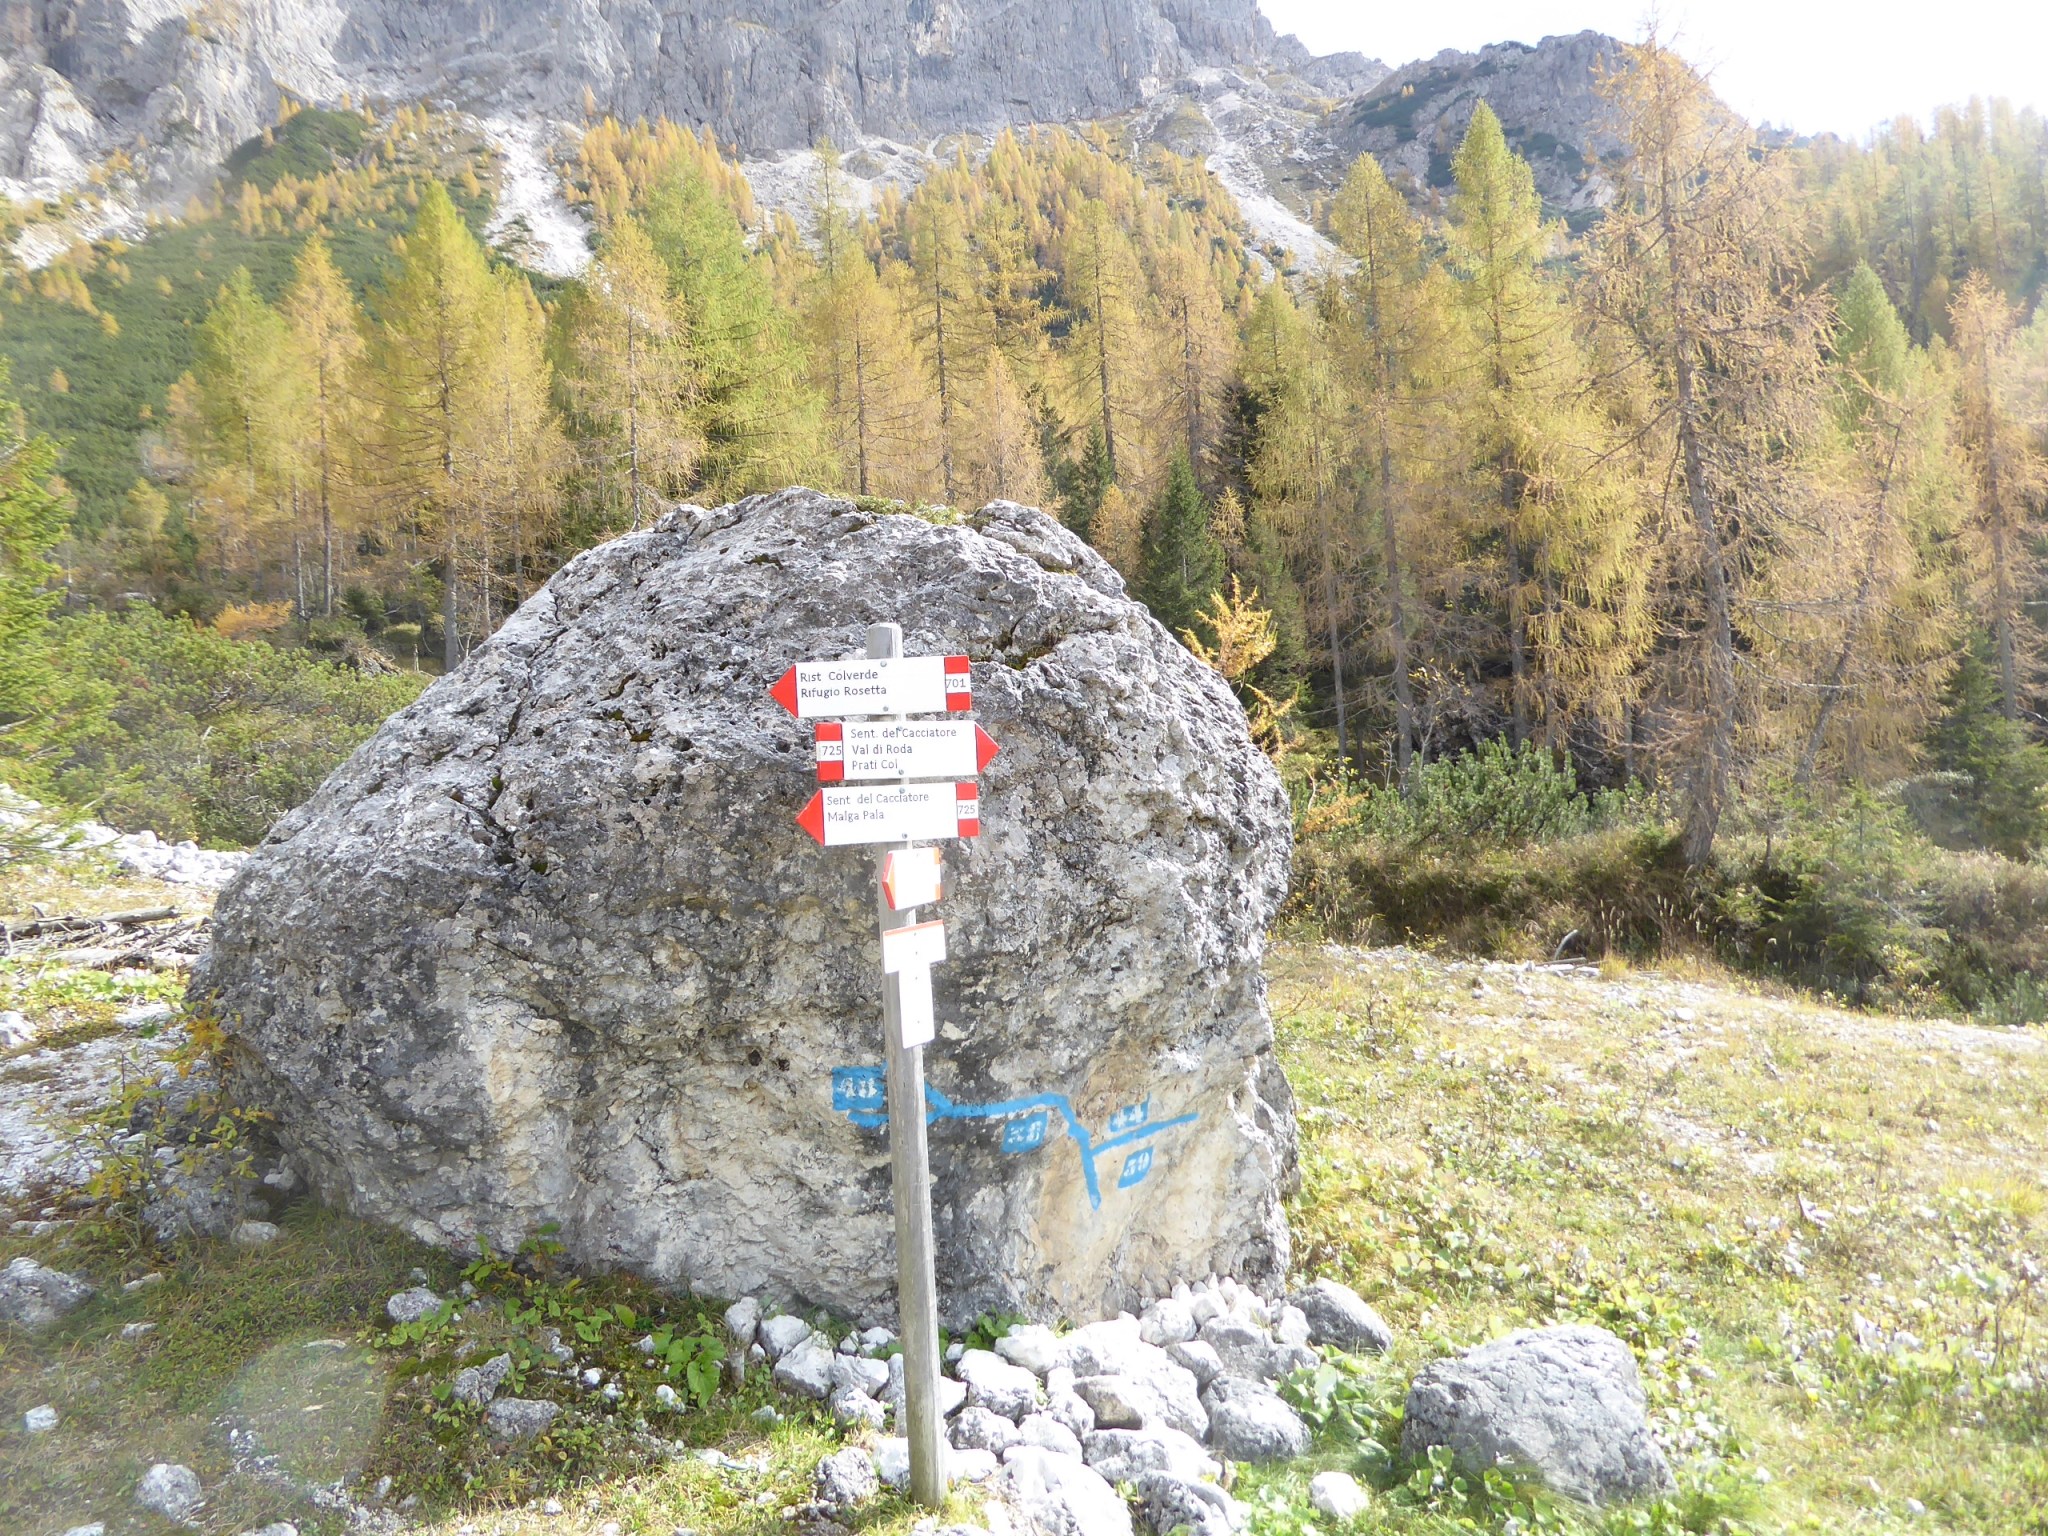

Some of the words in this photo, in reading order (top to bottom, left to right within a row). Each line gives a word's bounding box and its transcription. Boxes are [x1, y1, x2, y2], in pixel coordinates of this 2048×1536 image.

[828, 668, 879, 681] Colverde
[945, 678, 967, 689] 701
[800, 686, 840, 699] Rifugio
[844, 684, 887, 696] Rosetta
[882, 727, 899, 738] del
[902, 727, 957, 738] Cacciatore
[821, 745, 842, 756] 725
[851, 743, 869, 755] Val
[872, 743, 883, 755] di
[886, 743, 913, 755] Roda
[851, 759, 878, 771] Prati
[880, 758, 898, 770] Col
[856, 793, 873, 804] del
[875, 792, 930, 804] Cacciatore
[827, 810, 860, 823] Malga
[863, 808, 885, 820] Pala
[957, 804, 976, 815] 725
